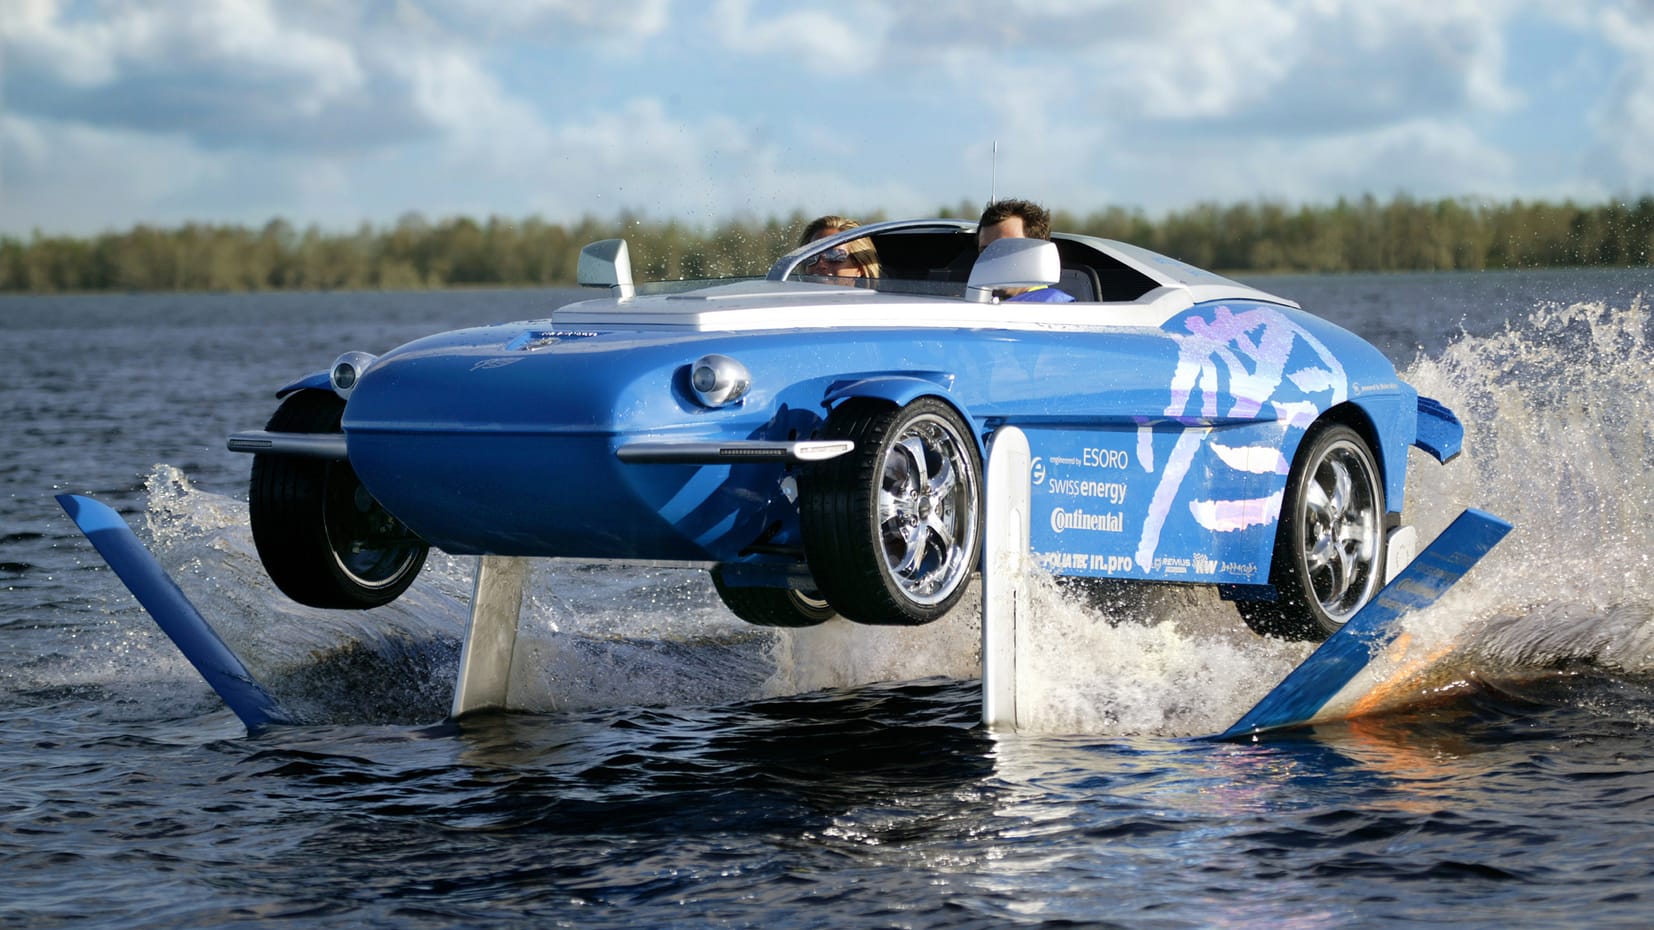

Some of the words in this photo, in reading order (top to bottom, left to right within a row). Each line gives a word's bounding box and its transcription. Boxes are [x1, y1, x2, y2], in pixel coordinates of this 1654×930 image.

[1083, 447, 1128, 469] ESORO
[1050, 507, 1123, 533] Continental
[1162, 557, 1190, 567] REMUS
